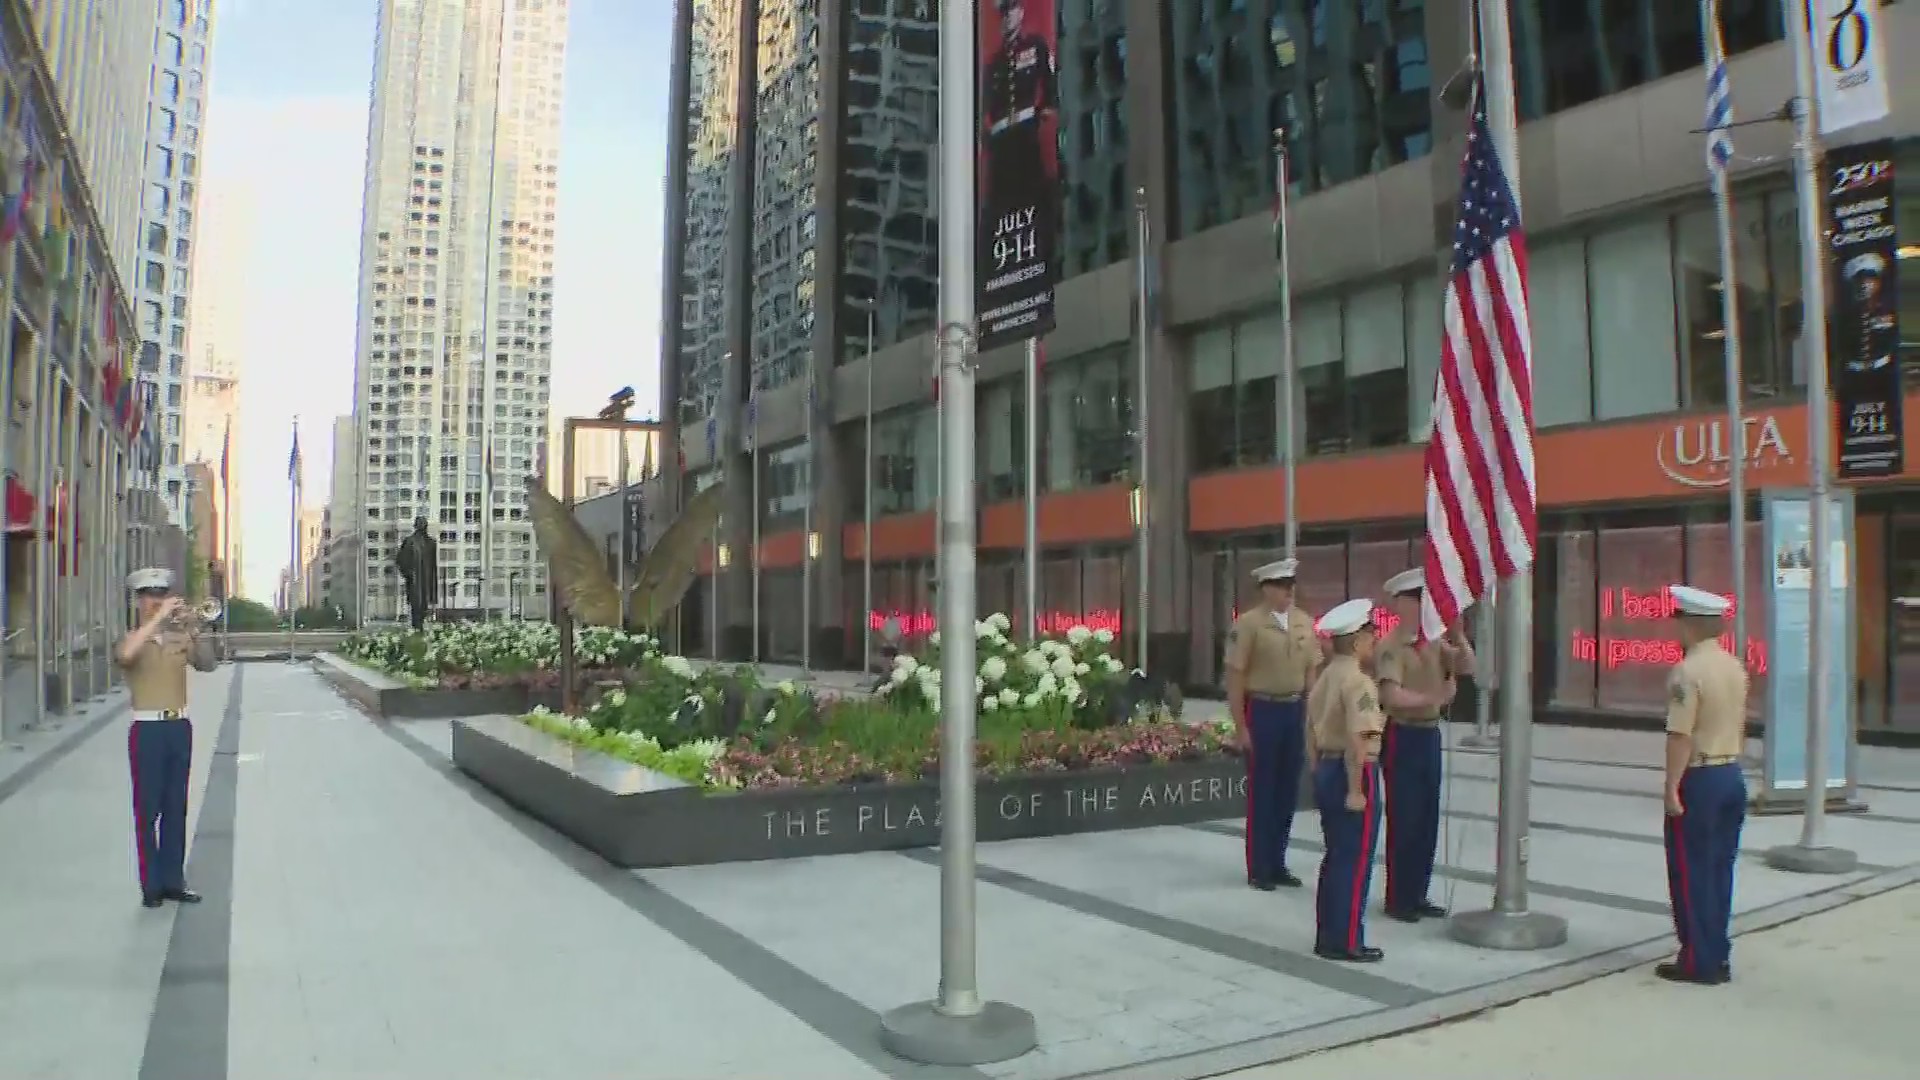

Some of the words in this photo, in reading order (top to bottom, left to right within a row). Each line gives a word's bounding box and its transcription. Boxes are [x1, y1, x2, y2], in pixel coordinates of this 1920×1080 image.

[994, 206, 1035, 236] JULY
[993, 228, 1036, 270] 9-14
[1675, 416, 1790, 465] ULTA
[1622, 586, 1737, 618] belie
[1572, 632, 1598, 661] in
[763, 808, 831, 839] THE
[858, 801, 943, 832] PLA
[1000, 793, 1042, 820] OF
[1064, 786, 1119, 816] THE
[1139, 775, 1248, 808] AMERIC
